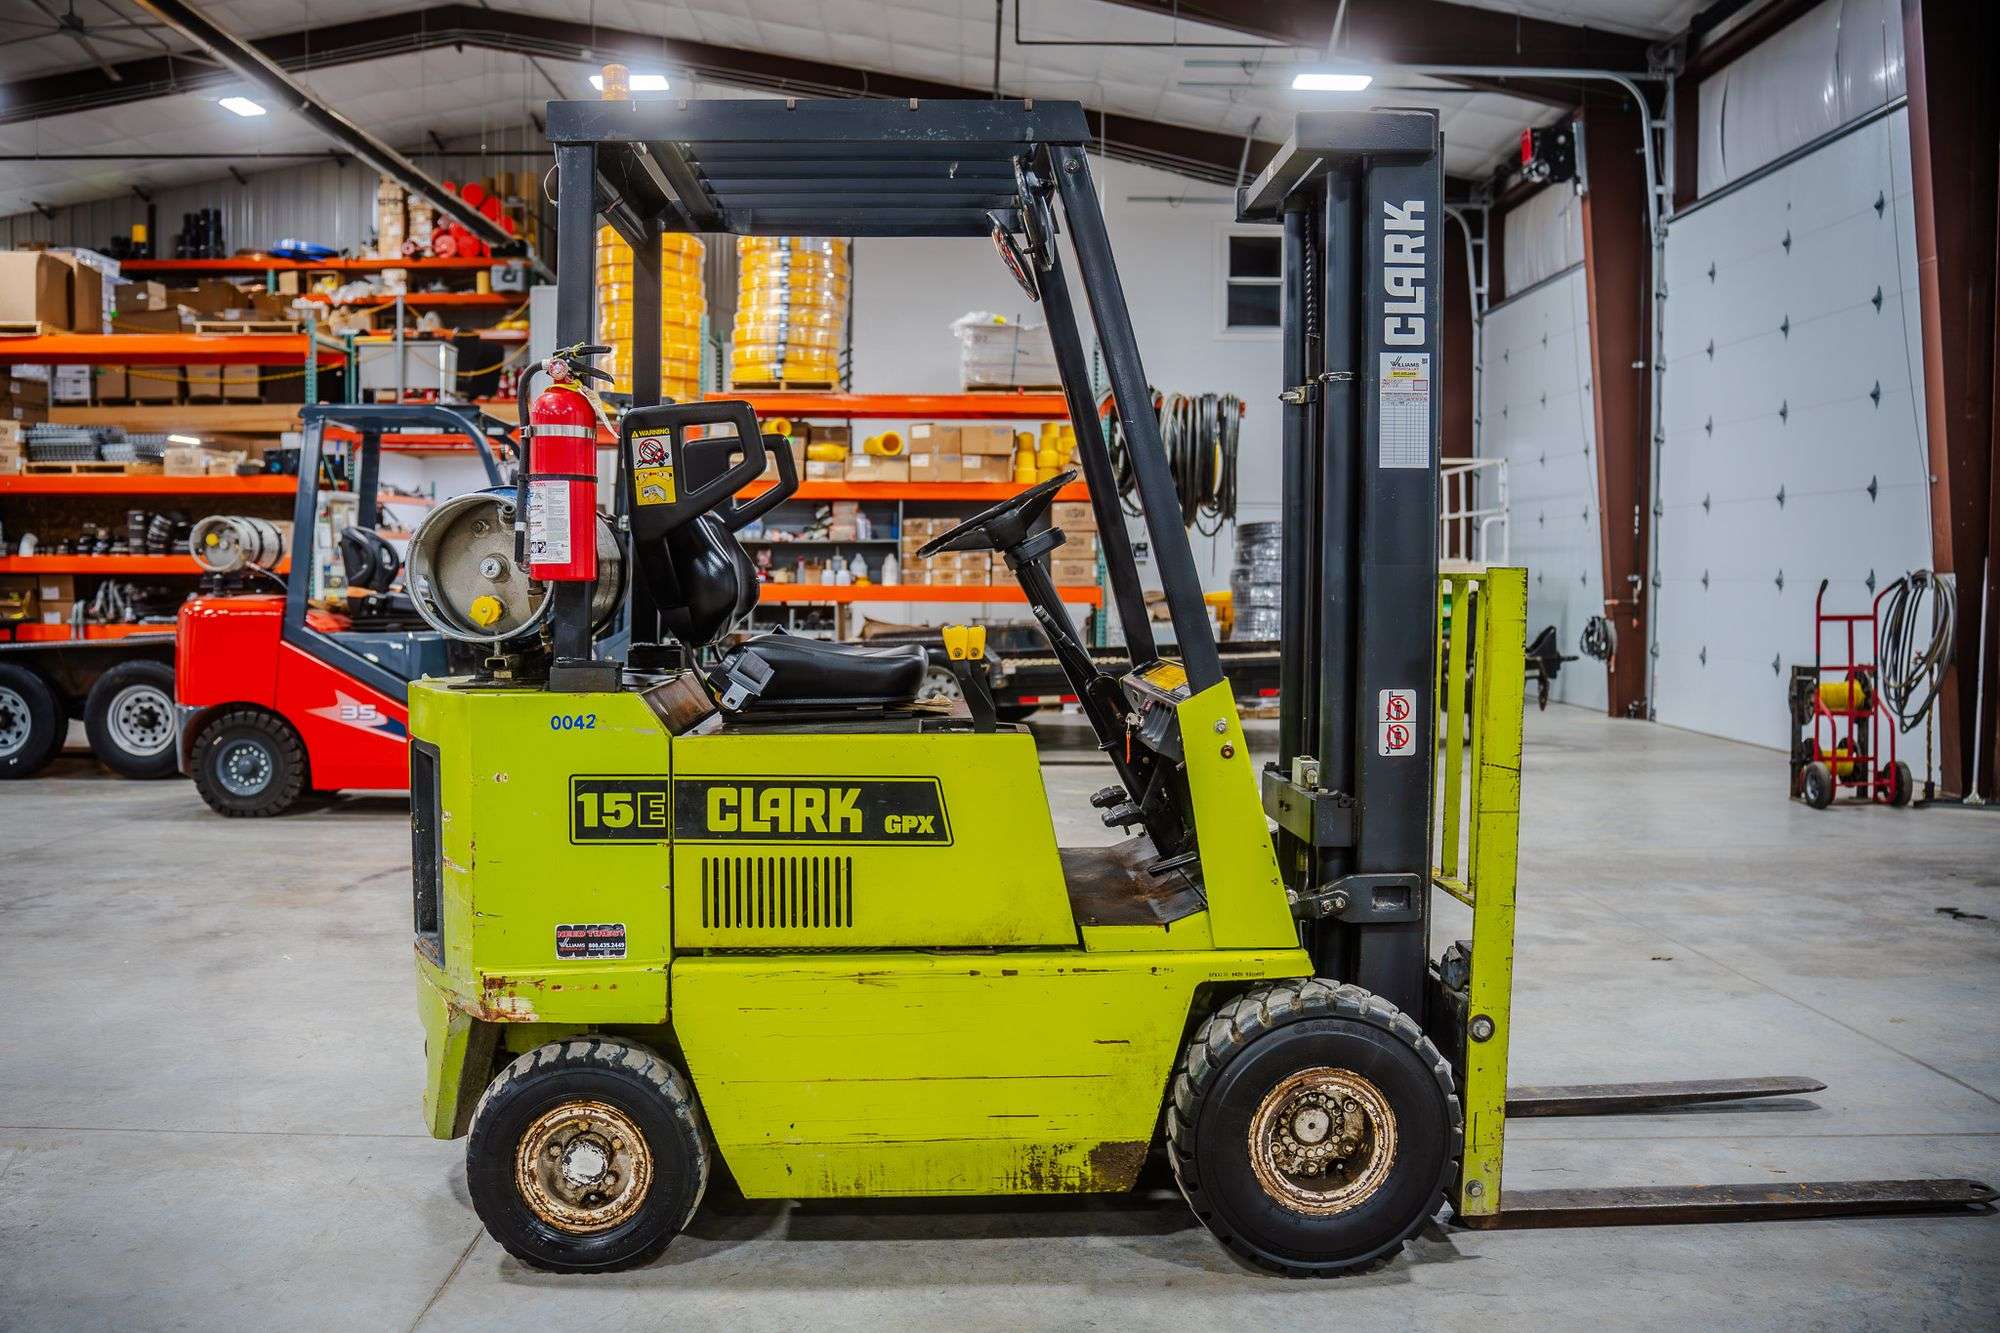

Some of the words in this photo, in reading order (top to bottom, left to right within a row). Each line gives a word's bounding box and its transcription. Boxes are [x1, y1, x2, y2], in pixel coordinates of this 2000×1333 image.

[1384, 201, 1425, 345] CLARK
[639, 428, 670, 436] WARNING
[341, 704, 376, 720] 35
[551, 714, 596, 730] 0042
[577, 792, 666, 828] 15E
[707, 787, 863, 833] CLARK
[885, 815, 935, 834] GPX
